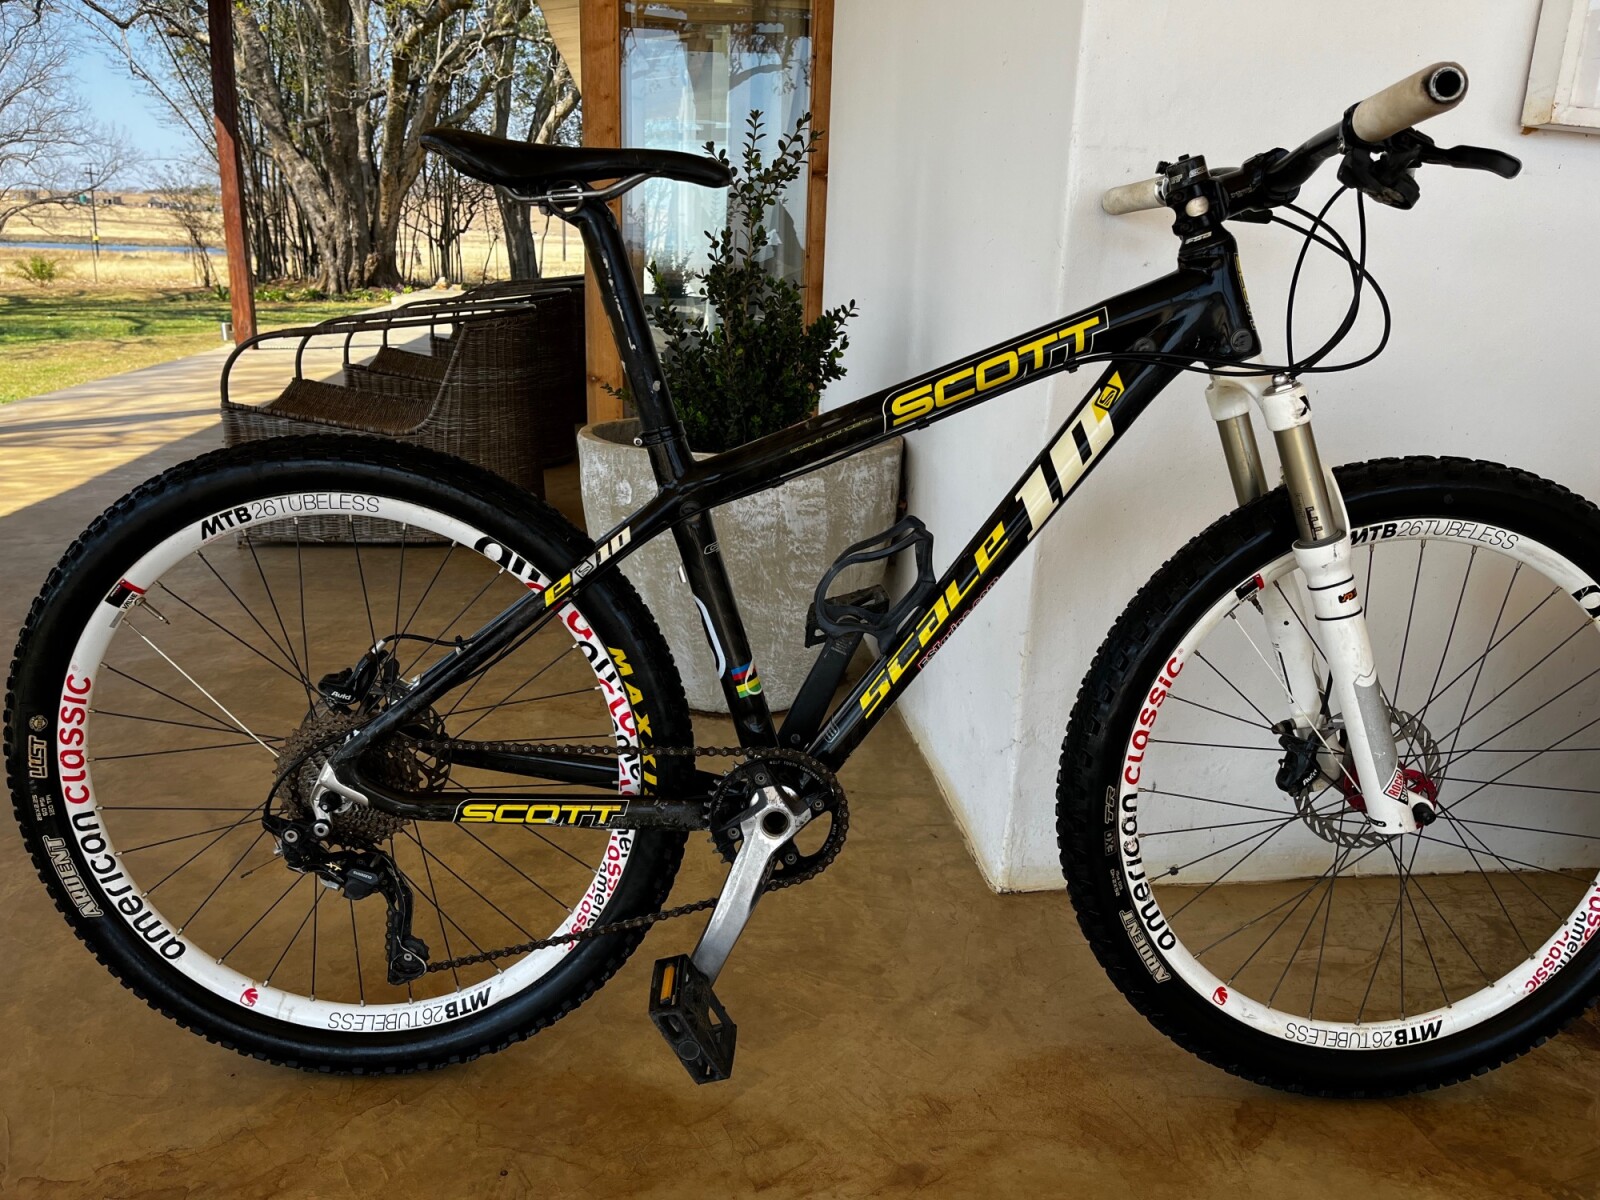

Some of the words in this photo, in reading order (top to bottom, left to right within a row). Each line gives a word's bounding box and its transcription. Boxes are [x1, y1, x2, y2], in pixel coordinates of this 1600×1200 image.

[892, 316, 1100, 427] SCOTT
[460, 803, 622, 825] SCOTT
[42, 834, 104, 918] ARDENT
[1119, 909, 1172, 984] ARDENT
